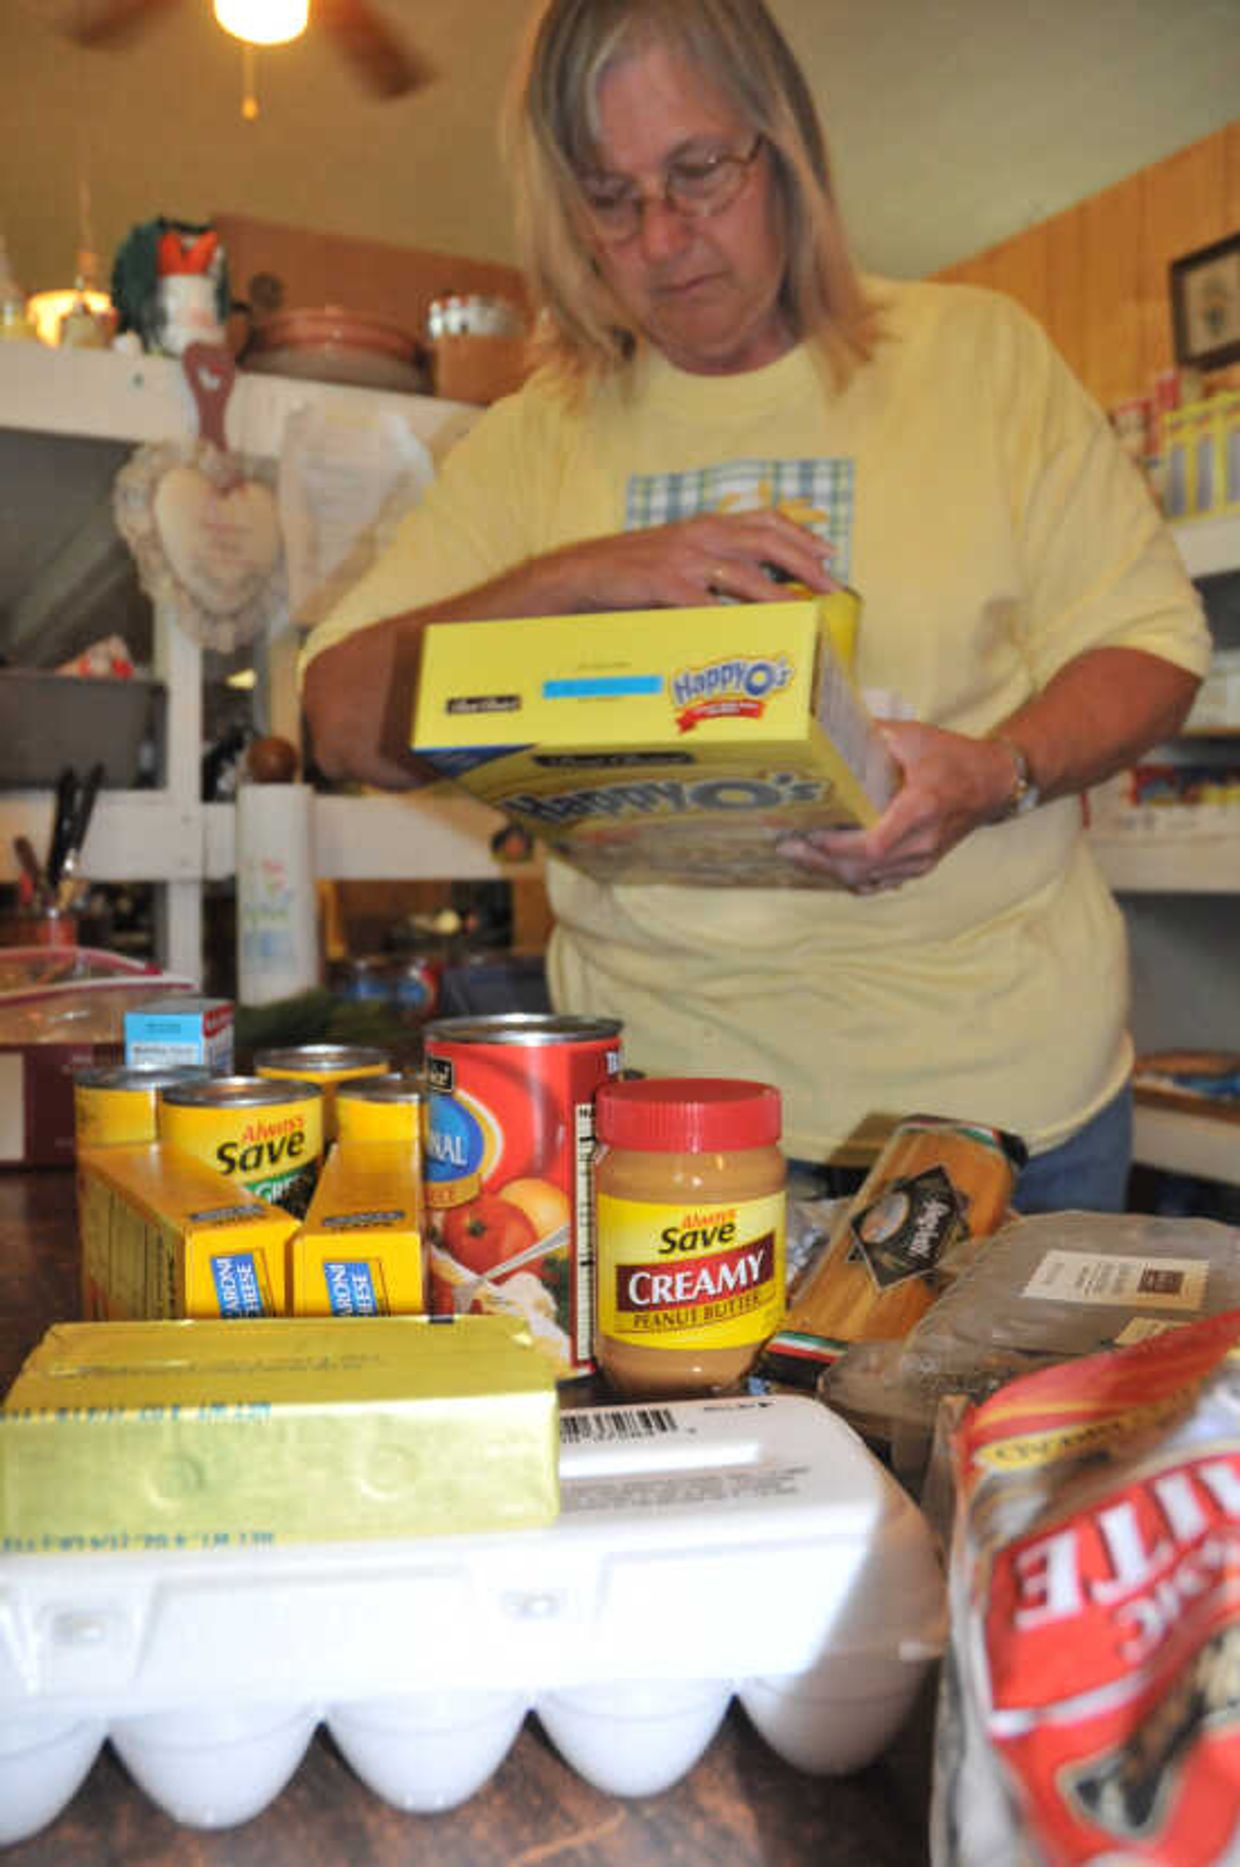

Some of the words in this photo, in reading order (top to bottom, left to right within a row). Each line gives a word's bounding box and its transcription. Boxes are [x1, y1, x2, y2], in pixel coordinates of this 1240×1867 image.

[216, 1131, 305, 1175] Save
[658, 1222, 736, 1254] Save
[628, 1249, 765, 1306] CREAMY
[633, 1308, 698, 1330] PEANUT
[703, 1295, 761, 1320] BUTTER
